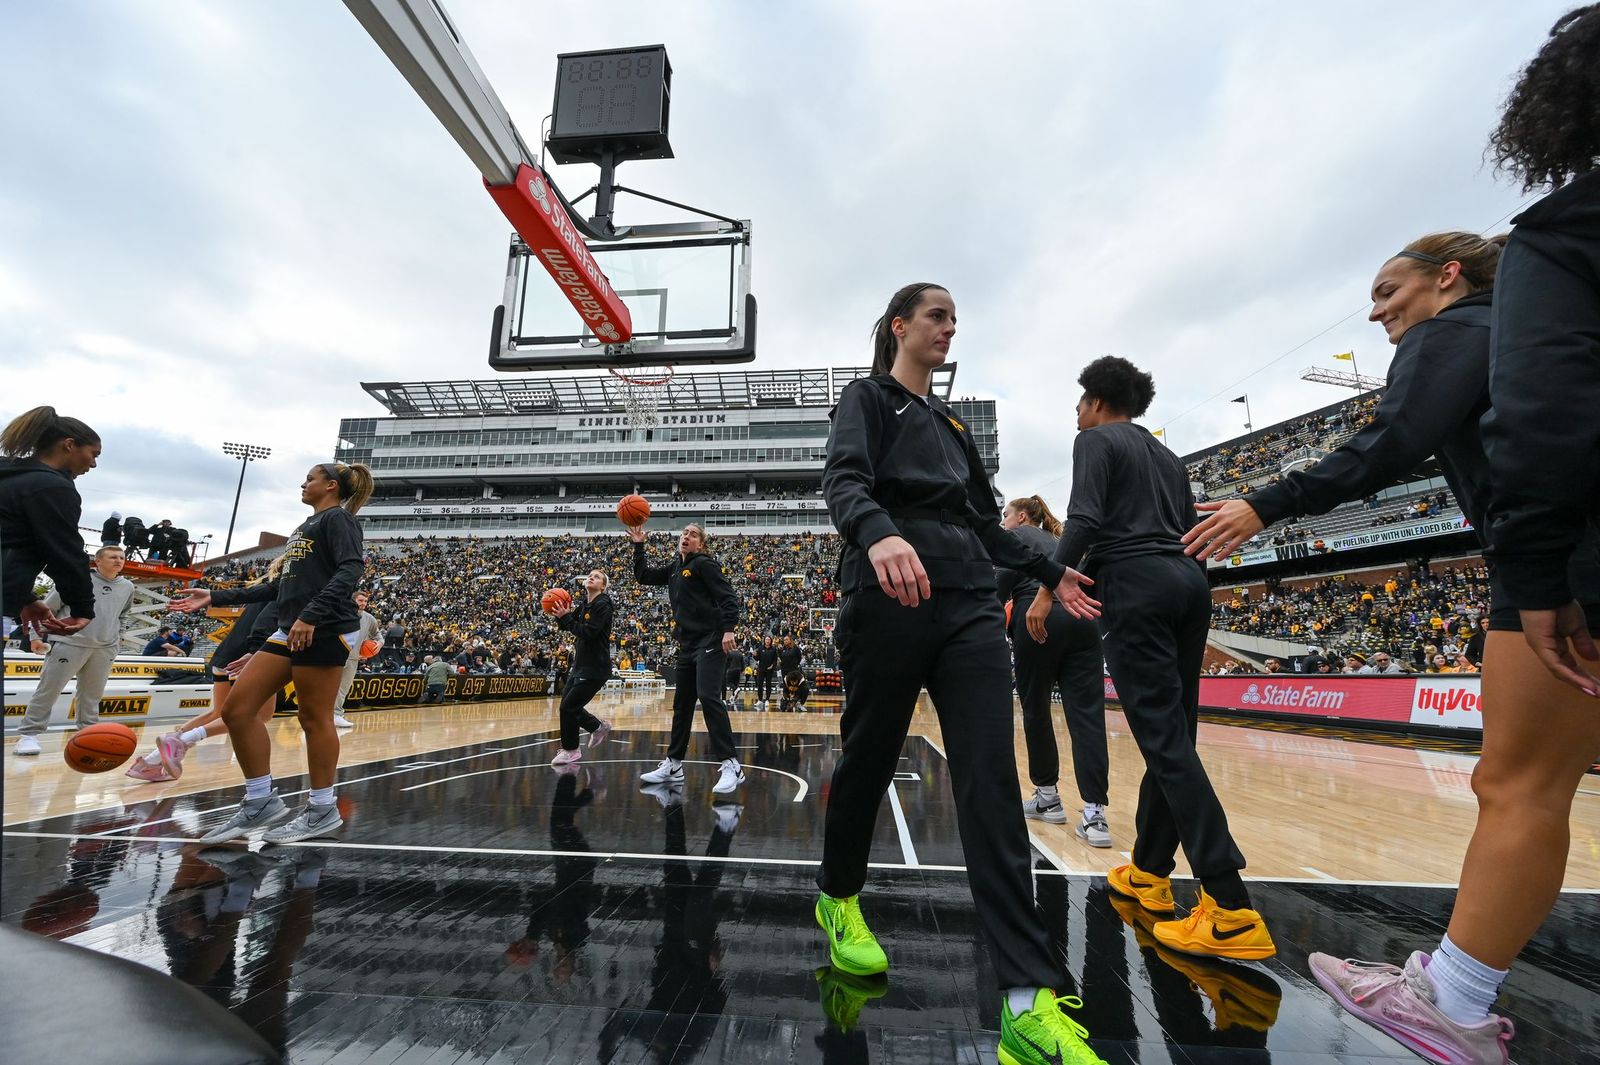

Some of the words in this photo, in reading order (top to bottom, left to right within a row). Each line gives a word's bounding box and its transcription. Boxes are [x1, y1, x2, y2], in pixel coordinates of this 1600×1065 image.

[579, 416, 640, 427] KINNIC
[662, 414, 726, 424] STADIUM
[1333, 541, 1342, 549] BY
[1342, 537, 1370, 548] FUELING
[1370, 534, 1380, 543] UP
[1380, 531, 1400, 542] WITH
[1401, 524, 1440, 538] UNLEADED
[1441, 521, 1453, 531] 88
[1276, 542, 1309, 561] WIN
[462, 678, 486, 695] AT
[489, 677, 545, 694] KINNICK
